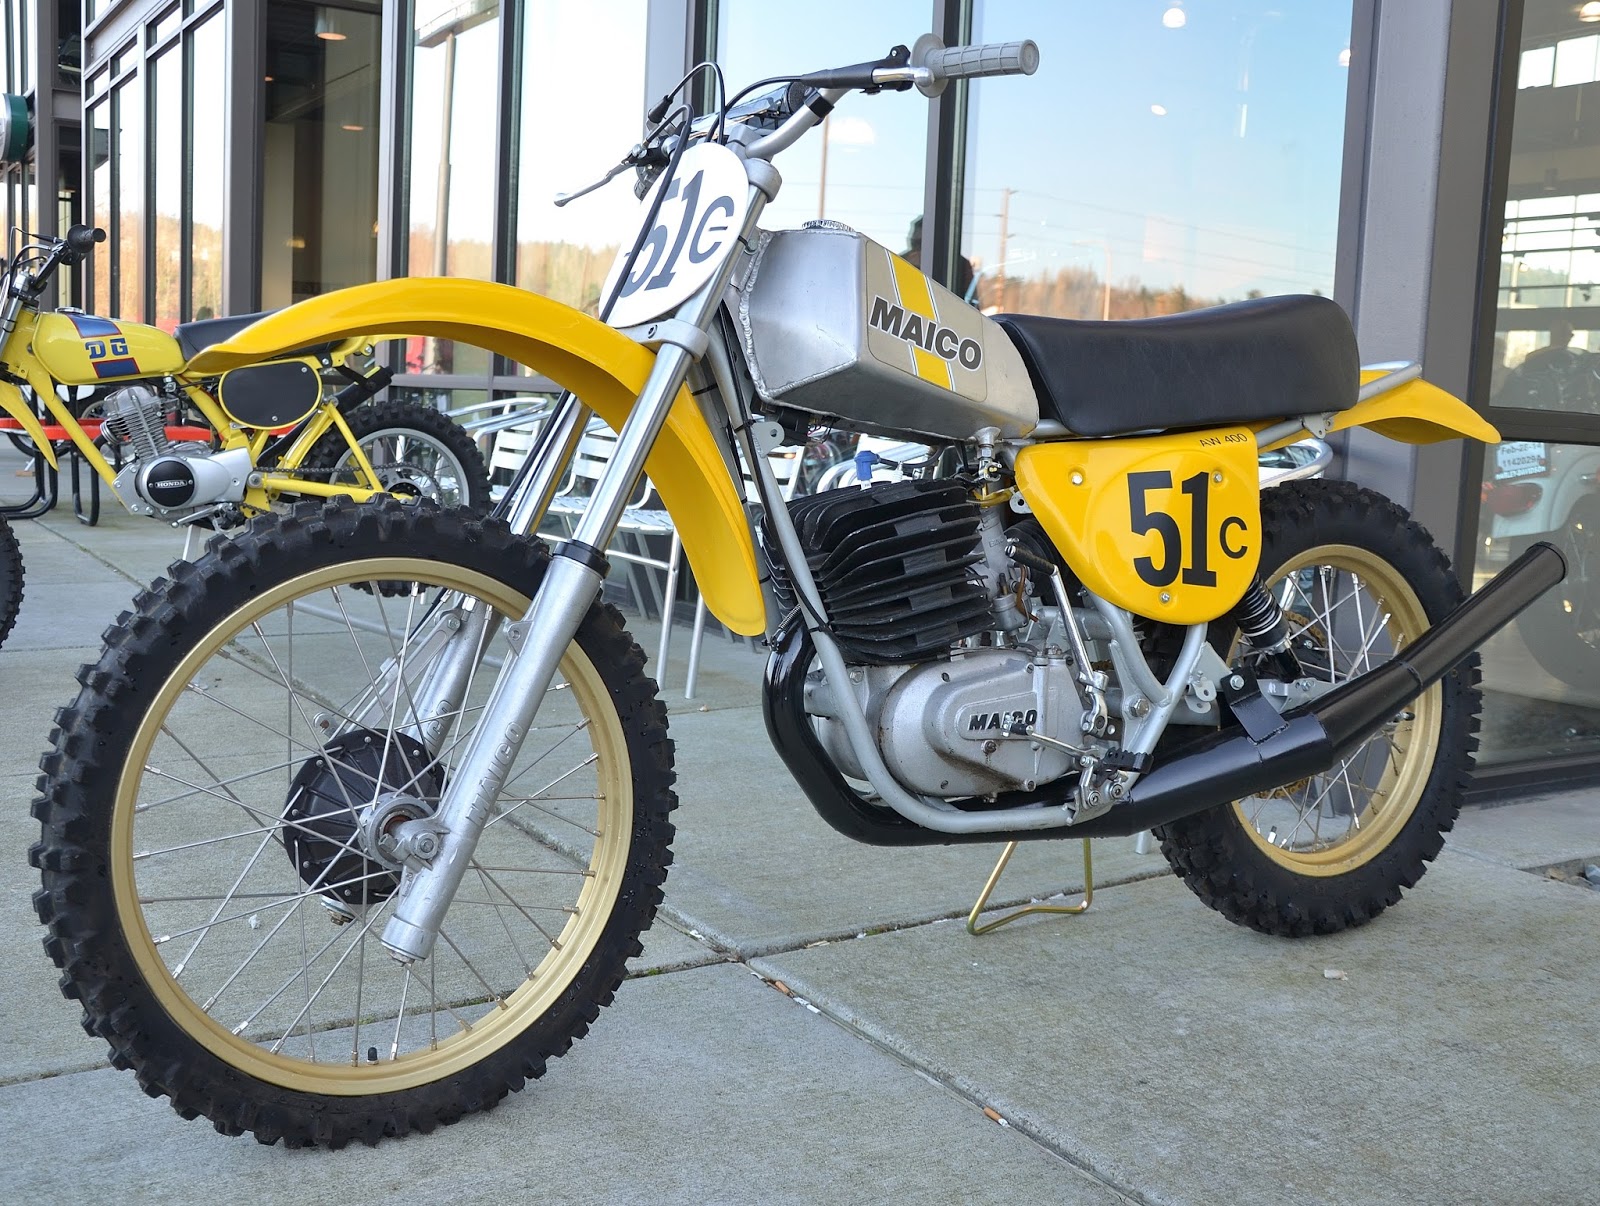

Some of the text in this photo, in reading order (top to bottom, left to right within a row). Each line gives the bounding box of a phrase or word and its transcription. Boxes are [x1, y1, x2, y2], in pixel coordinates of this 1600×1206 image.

[85, 338, 129, 359] DG
[868, 295, 983, 371] MAICO
[1224, 433, 1248, 443] 400
[466, 722, 523, 827] MAICO
